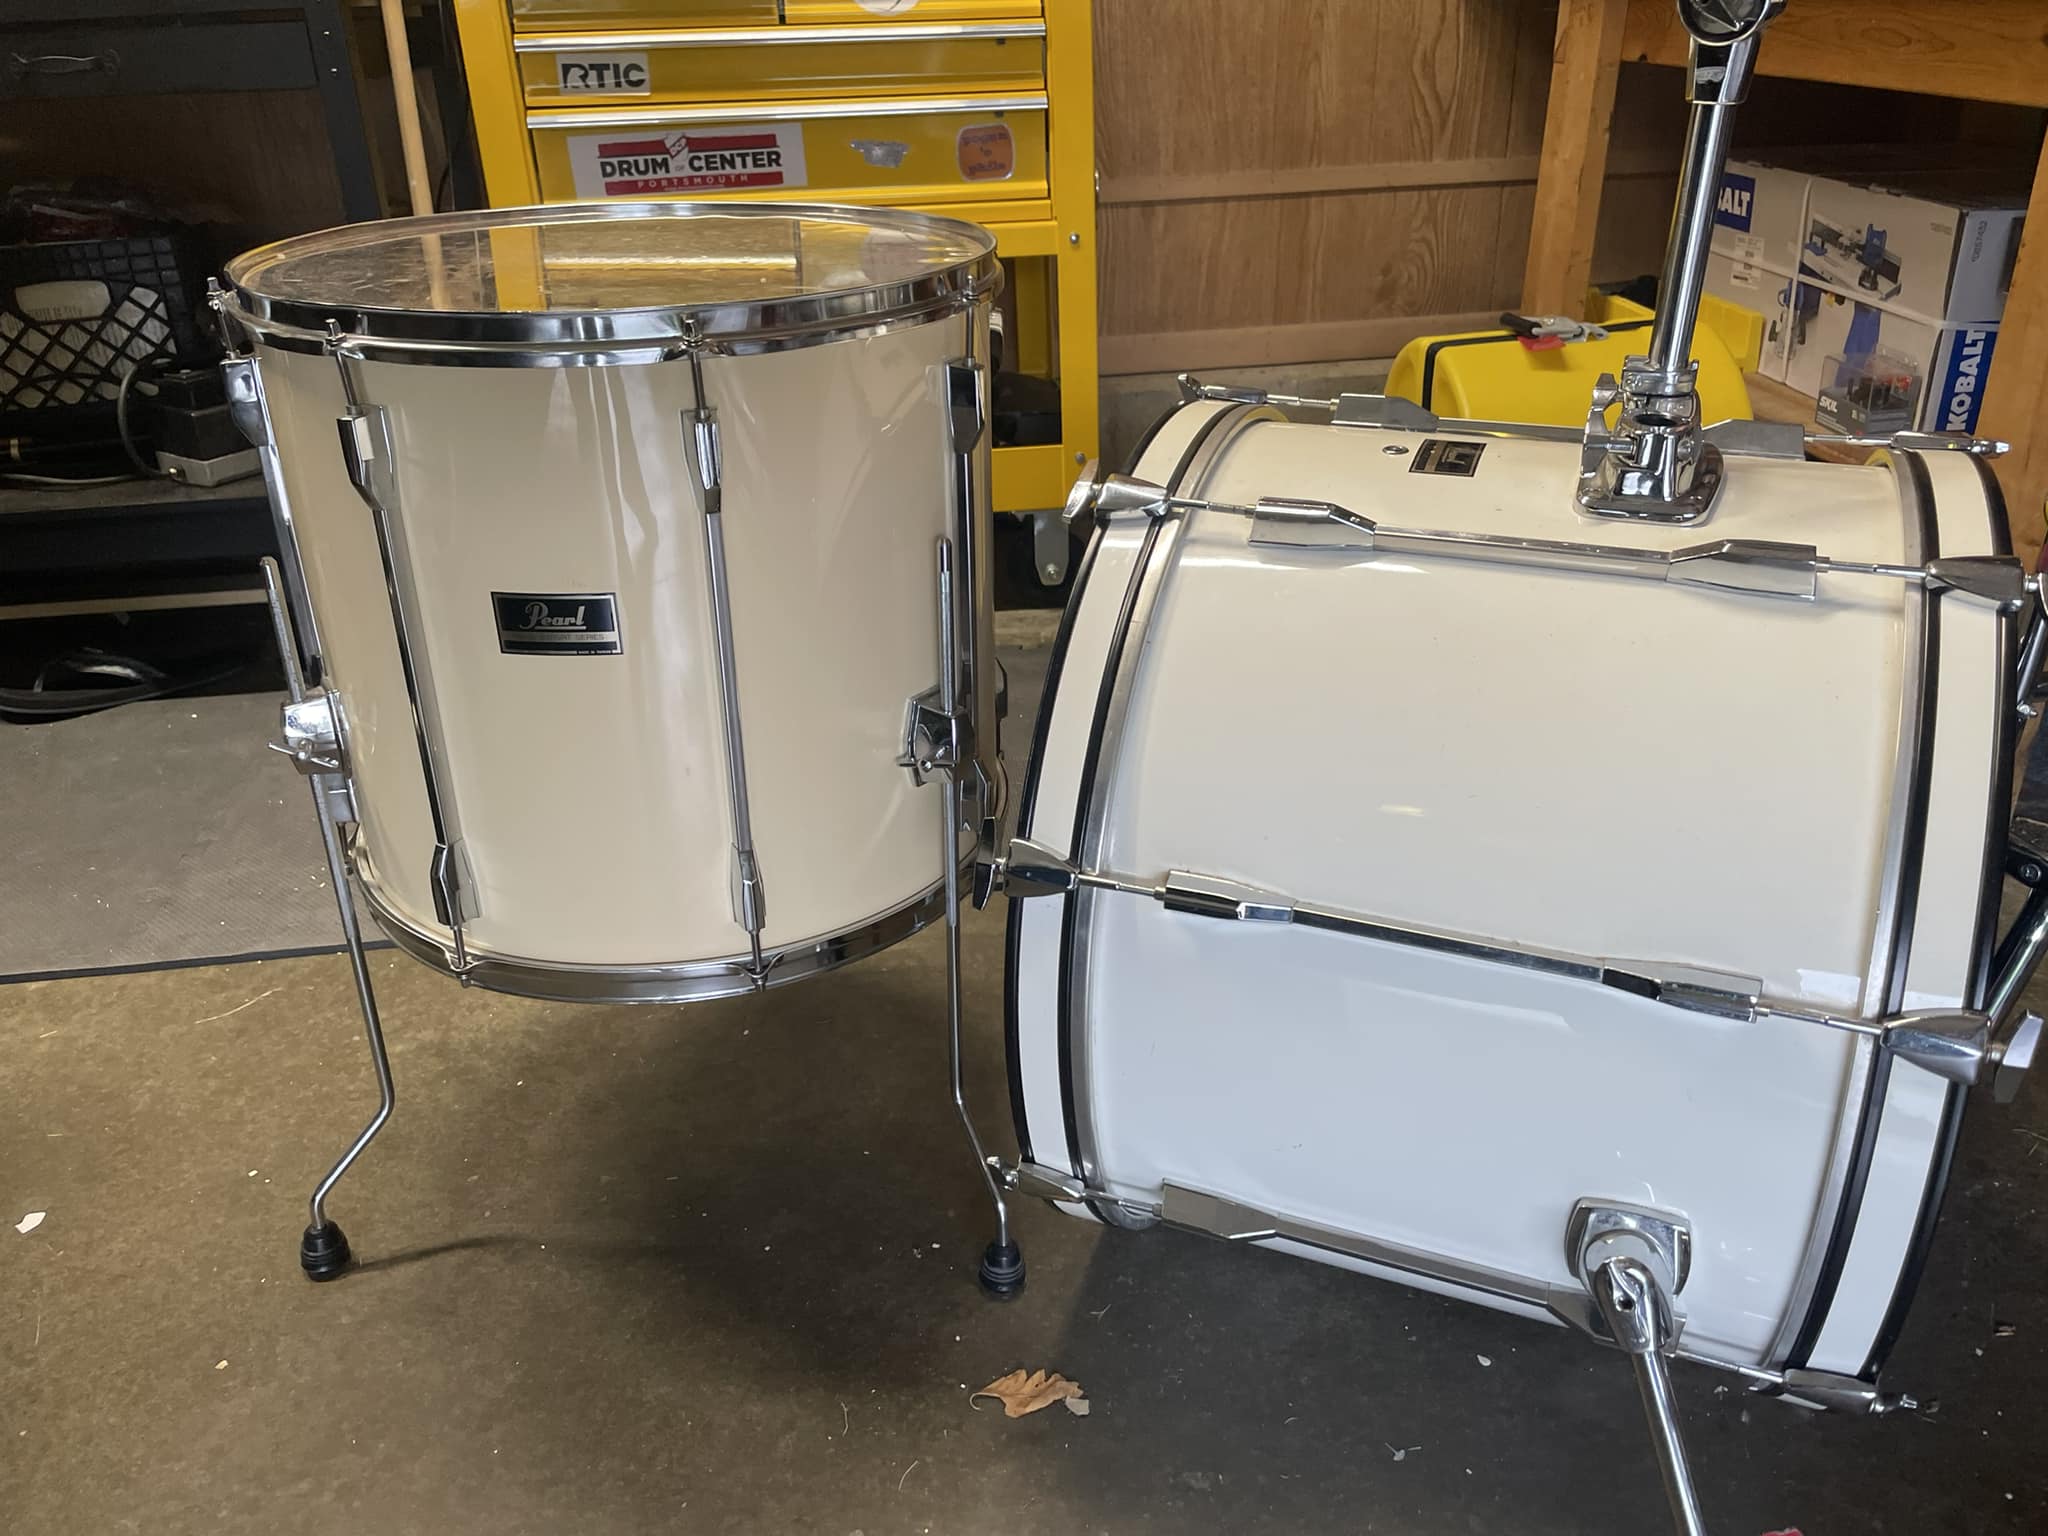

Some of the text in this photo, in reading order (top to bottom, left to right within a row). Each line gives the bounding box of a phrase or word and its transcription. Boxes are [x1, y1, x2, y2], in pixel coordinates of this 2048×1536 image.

[561, 63, 646, 88] RTIC
[600, 157, 670, 179] DRUM
[688, 150, 782, 173] CENTER
[637, 175, 750, 189] PORTSMOUTH
[1718, 186, 1751, 217] ALT
[1946, 329, 1987, 431] KOBALT
[1819, 396, 1838, 413] SKIL
[519, 601, 586, 630] Pearl
